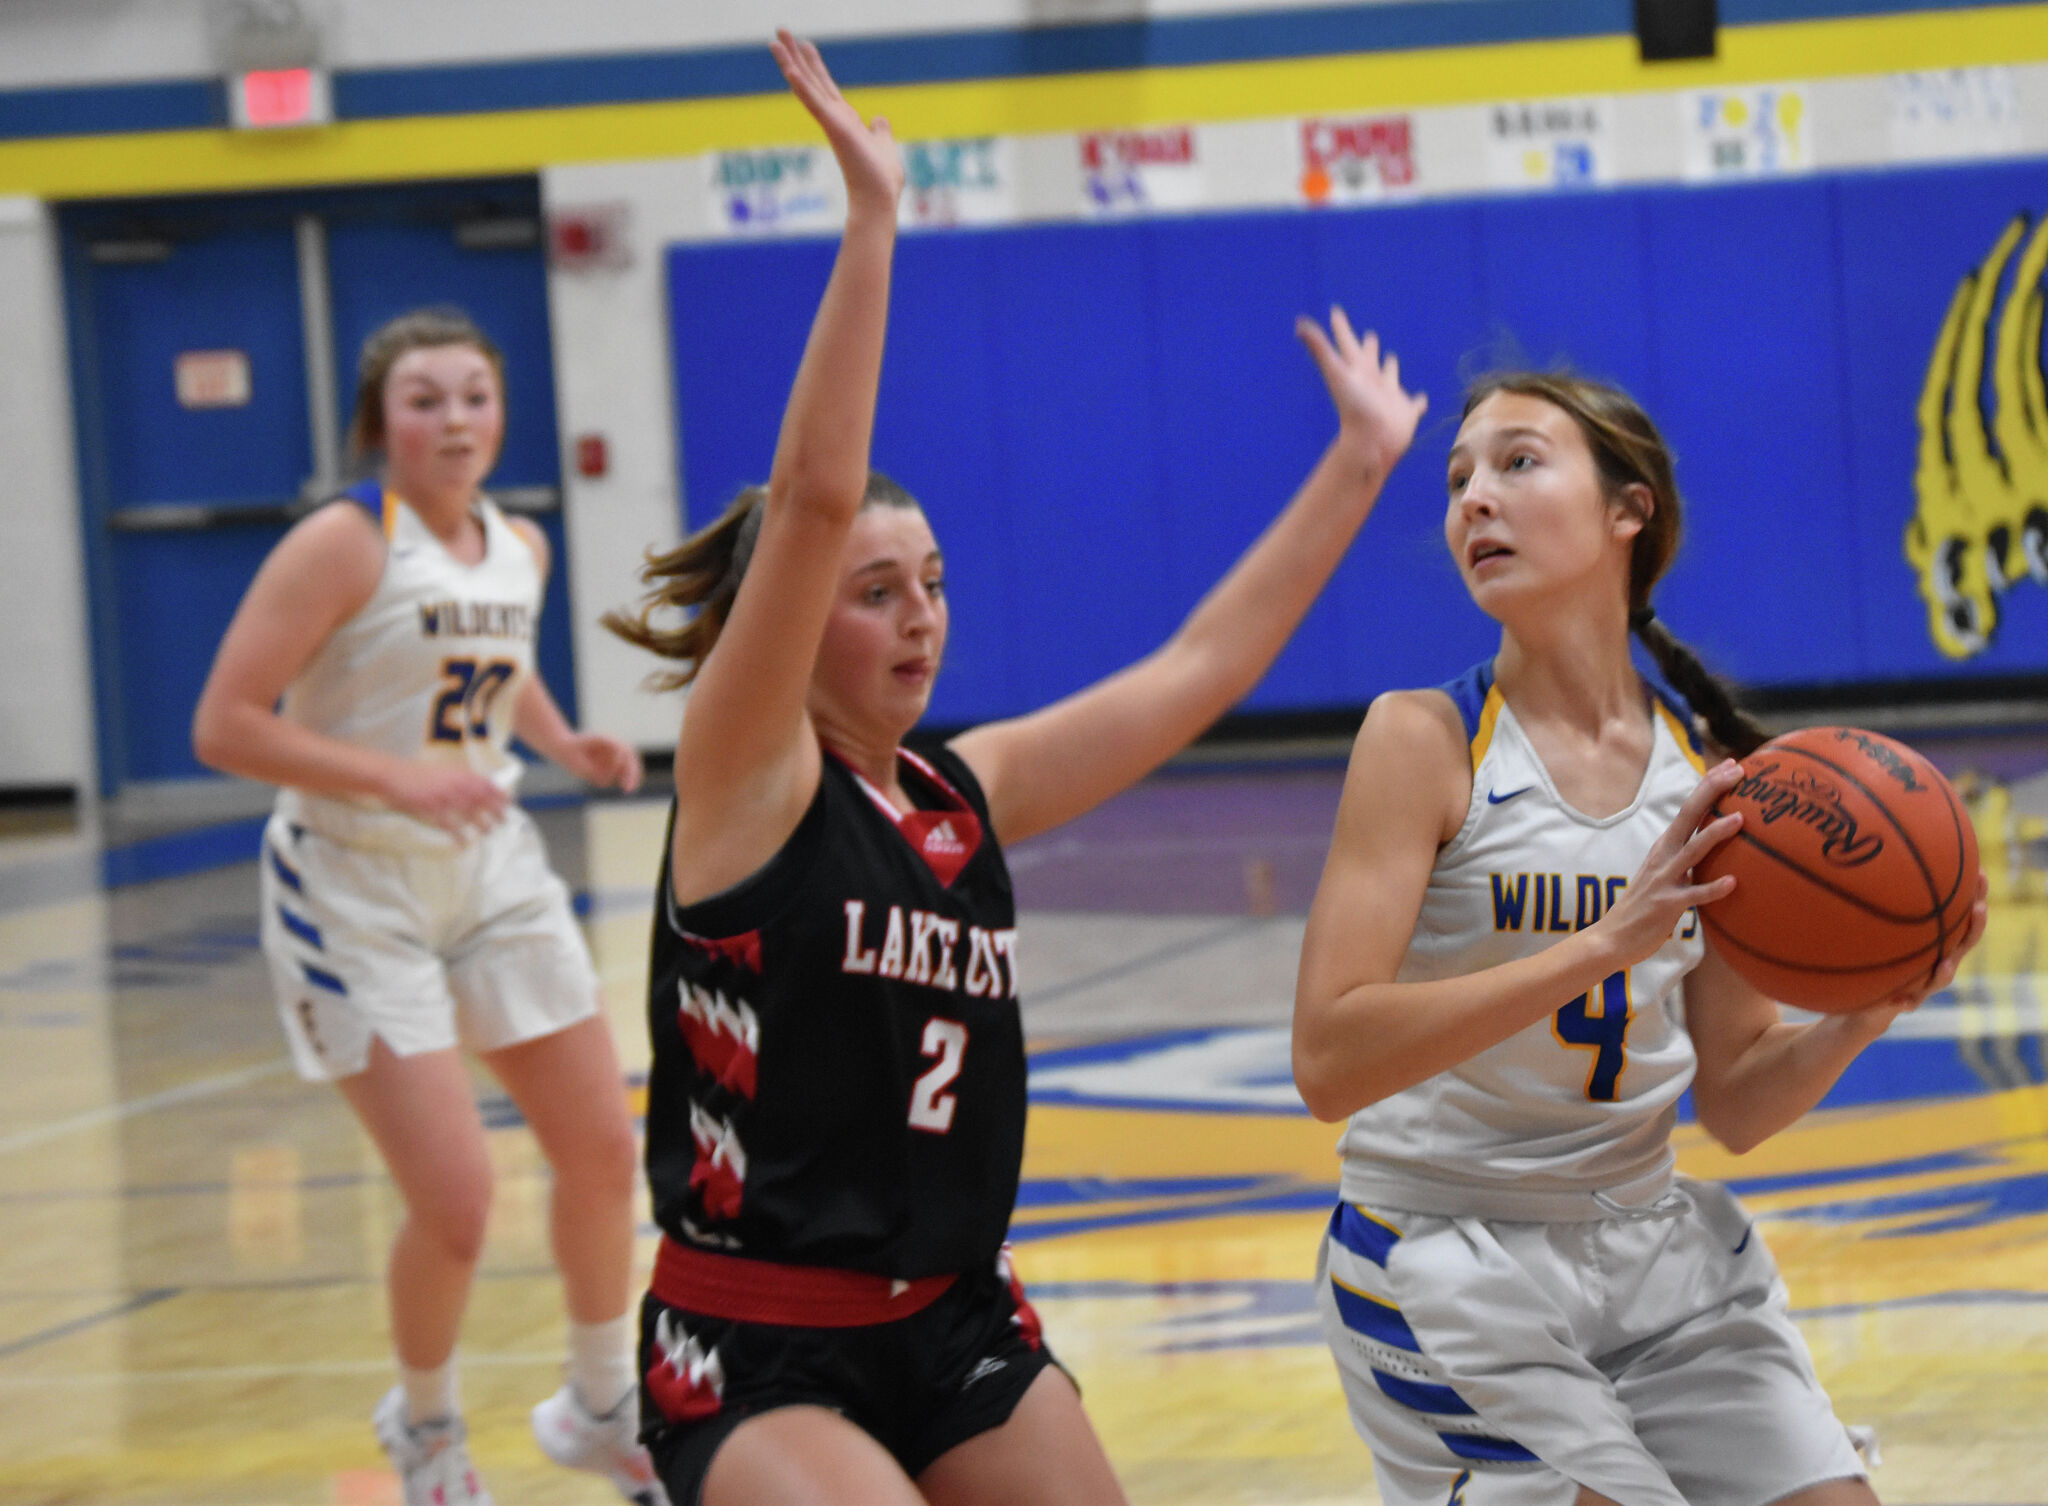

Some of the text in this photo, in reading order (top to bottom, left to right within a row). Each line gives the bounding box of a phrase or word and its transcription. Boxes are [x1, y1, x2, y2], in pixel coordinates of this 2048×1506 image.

[1728, 763, 1884, 869] Rawling
[842, 899, 1019, 1000] LAKE CIT
[907, 1016, 970, 1135] 2
[1551, 966, 1637, 1104] 4
